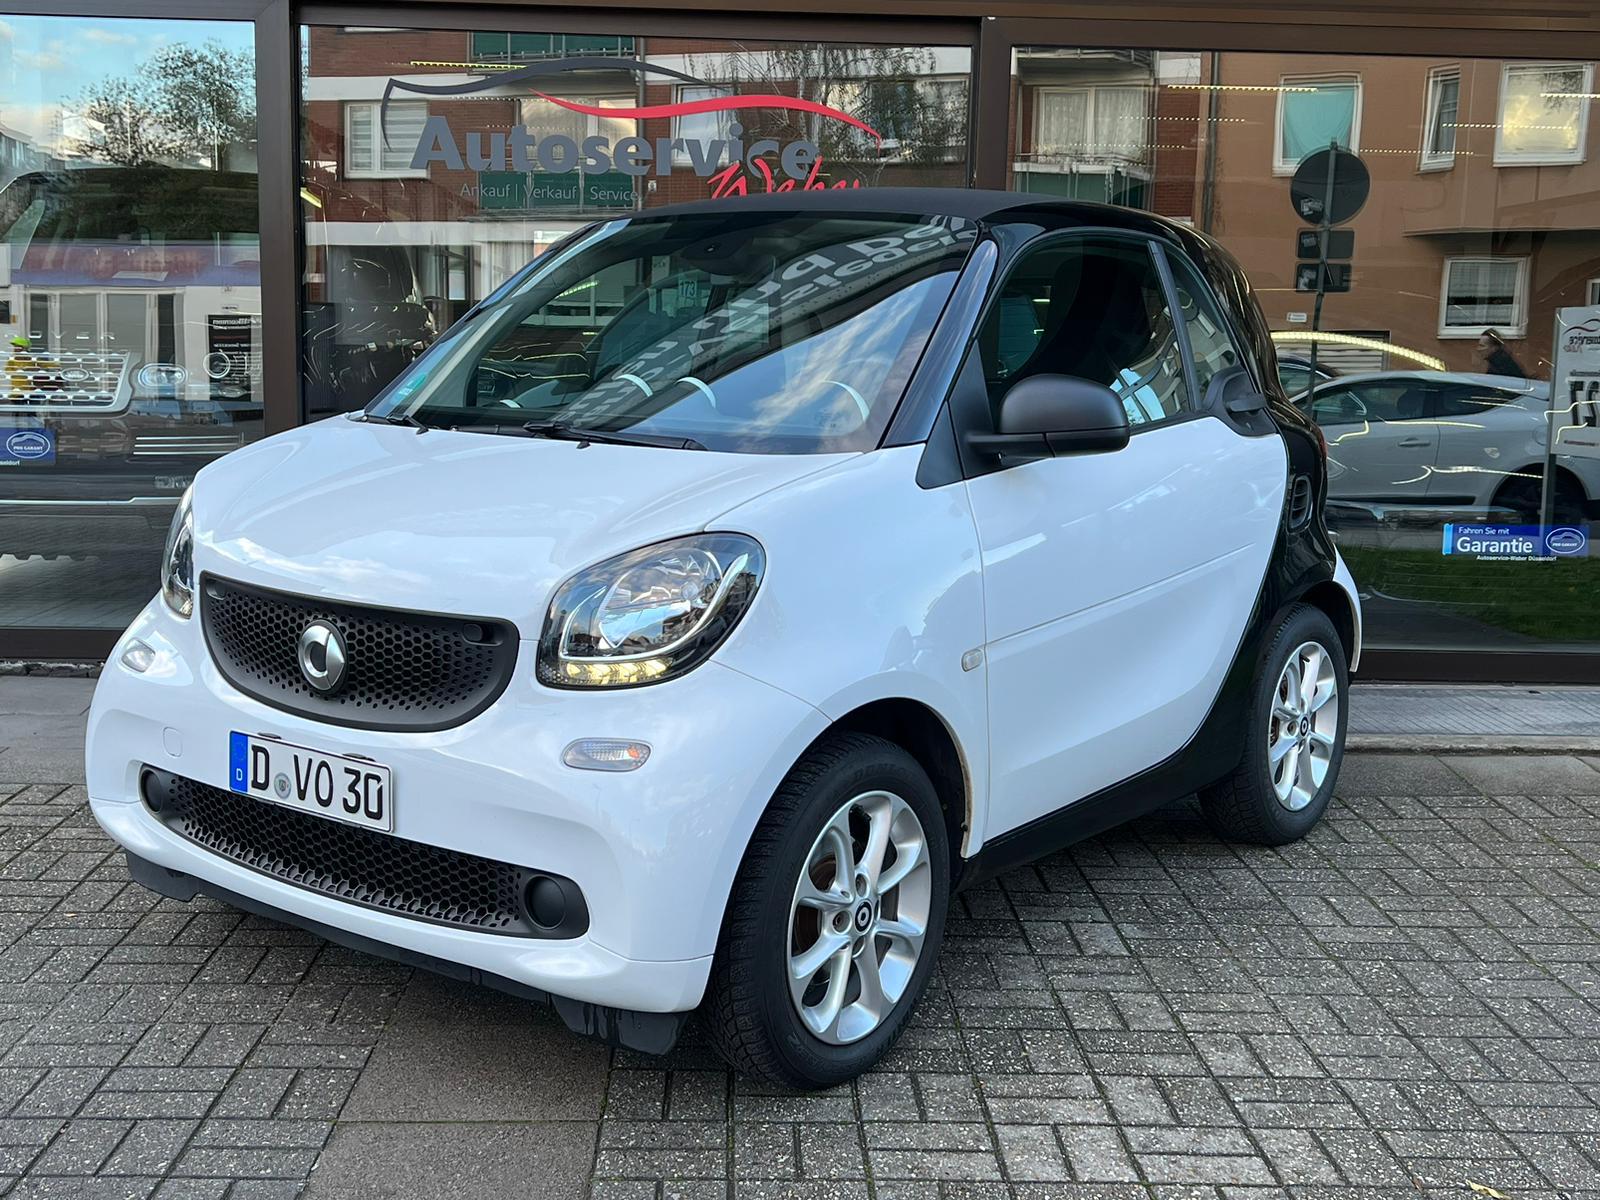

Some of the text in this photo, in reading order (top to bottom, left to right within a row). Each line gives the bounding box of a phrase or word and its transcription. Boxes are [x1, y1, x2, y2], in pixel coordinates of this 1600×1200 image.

[409, 115, 820, 180] Autoservice
[460, 183, 638, 201] Ankauf Verkauf Service
[1458, 527, 1484, 535] Fahren
[1457, 537, 1533, 553] Garantie
[251, 745, 383, 820] D VO 30
